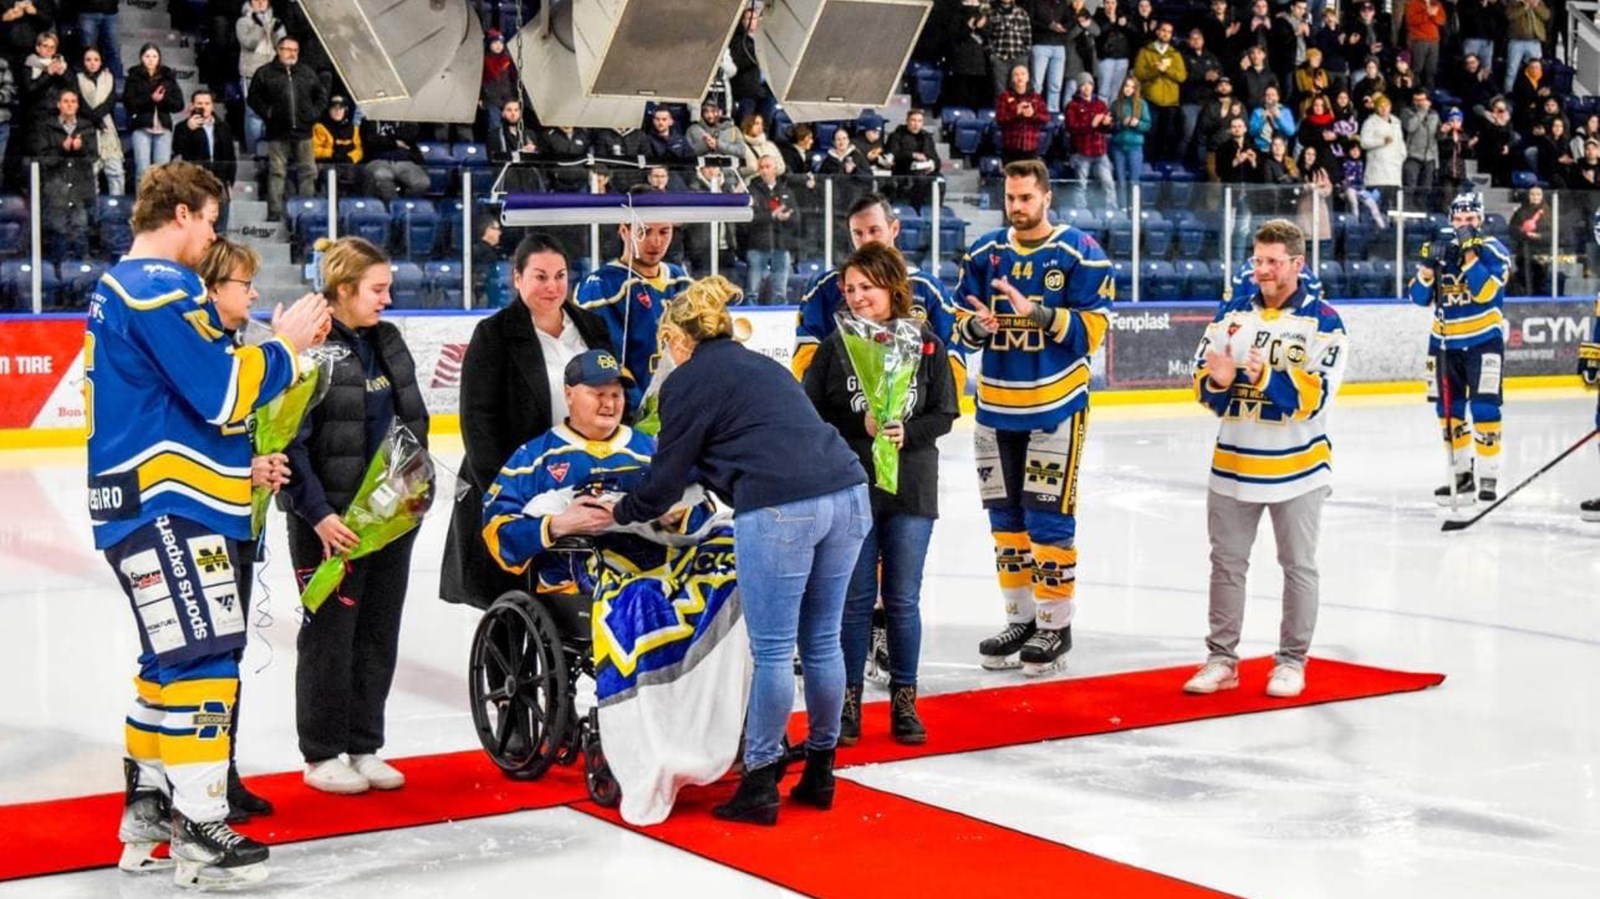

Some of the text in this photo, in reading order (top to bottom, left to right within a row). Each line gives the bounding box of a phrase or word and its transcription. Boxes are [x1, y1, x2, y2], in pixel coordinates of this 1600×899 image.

[1012, 261, 1033, 280] 44
[1109, 312, 1170, 332] Fenplast
[1269, 340, 1282, 365] C
[16, 356, 53, 374] TIRE
[58, 407, 82, 417] Bon
